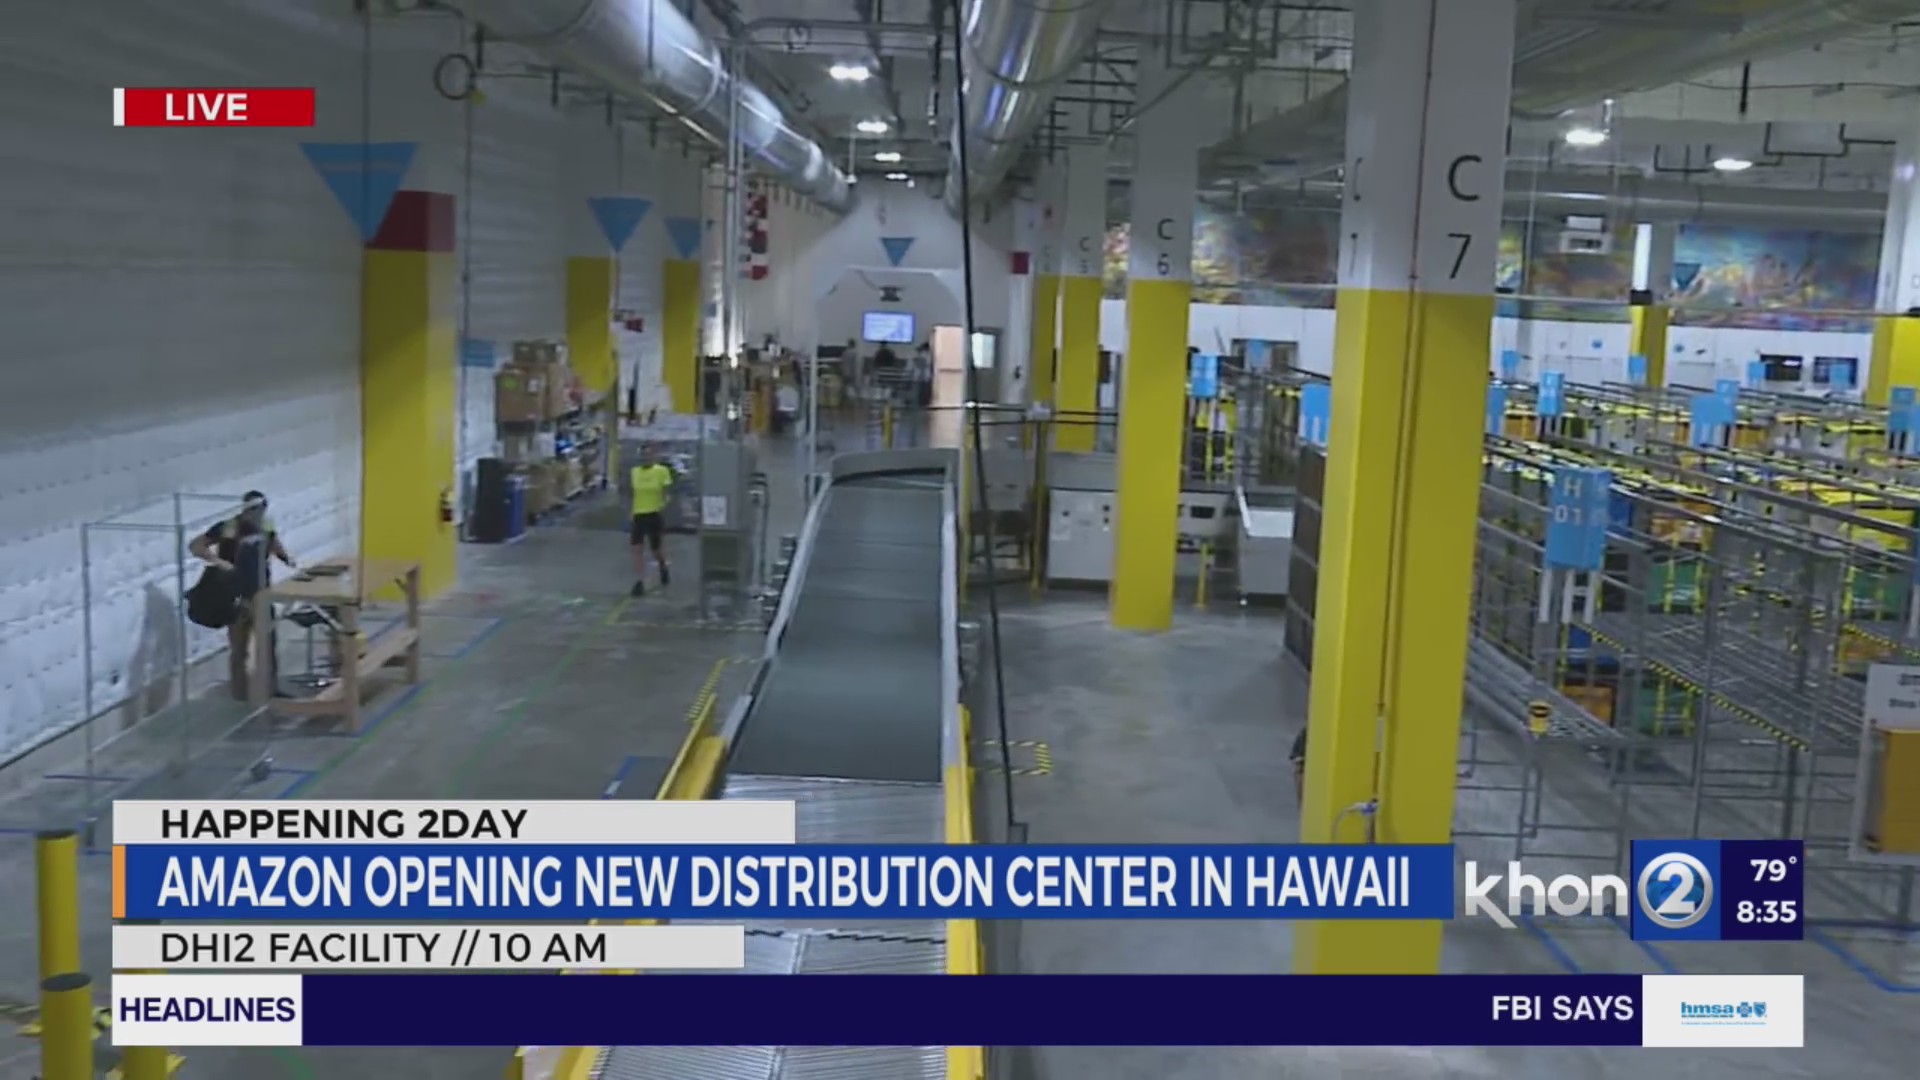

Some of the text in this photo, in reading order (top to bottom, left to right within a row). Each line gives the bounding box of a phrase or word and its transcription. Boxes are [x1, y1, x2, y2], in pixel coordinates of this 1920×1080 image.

[1448, 154, 1482, 202] C
[1157, 218, 1175, 241] C
[1157, 253, 1170, 276] 6
[1447, 232, 1472, 279] 7
